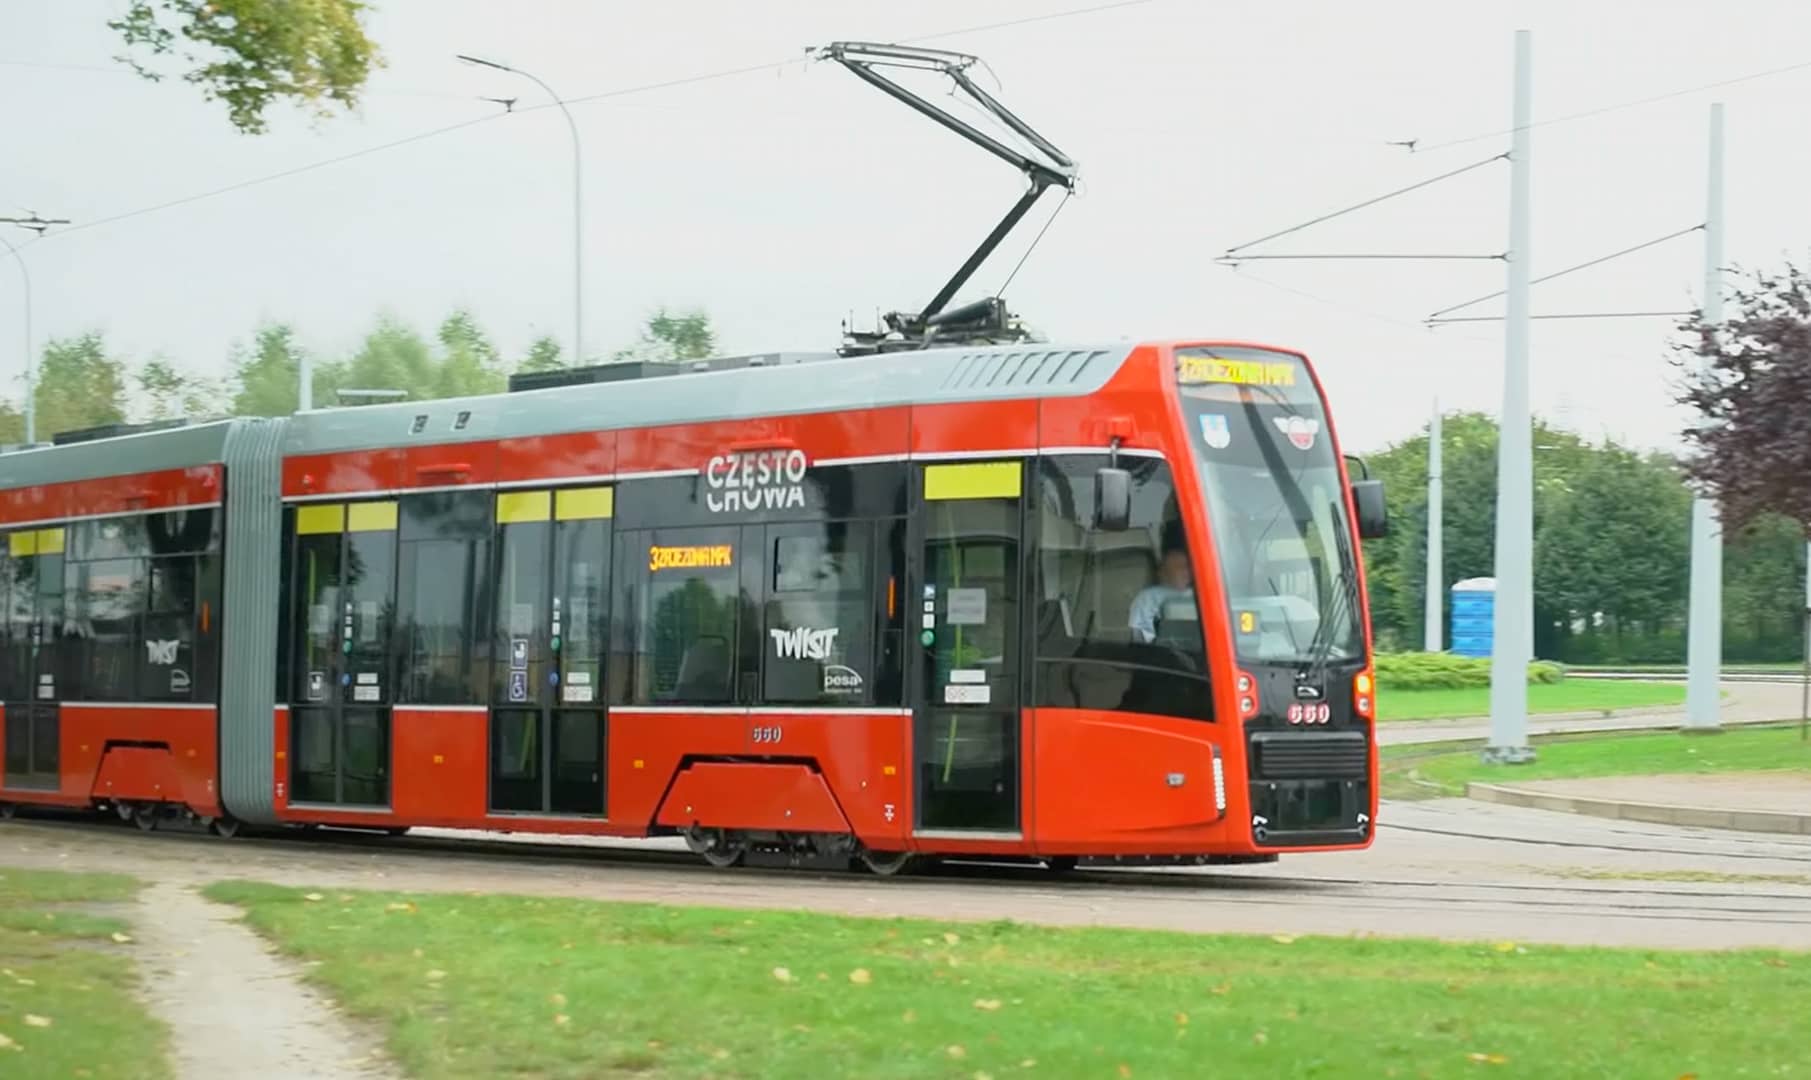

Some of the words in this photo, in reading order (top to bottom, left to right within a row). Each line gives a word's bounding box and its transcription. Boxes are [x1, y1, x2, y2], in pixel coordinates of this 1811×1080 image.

[707, 449, 807, 488] CZĘSTO
[1240, 612, 1254, 633] 3
[770, 627, 839, 659] TWIST
[1288, 703, 1330, 724] 660
[753, 726, 782, 743] 660
